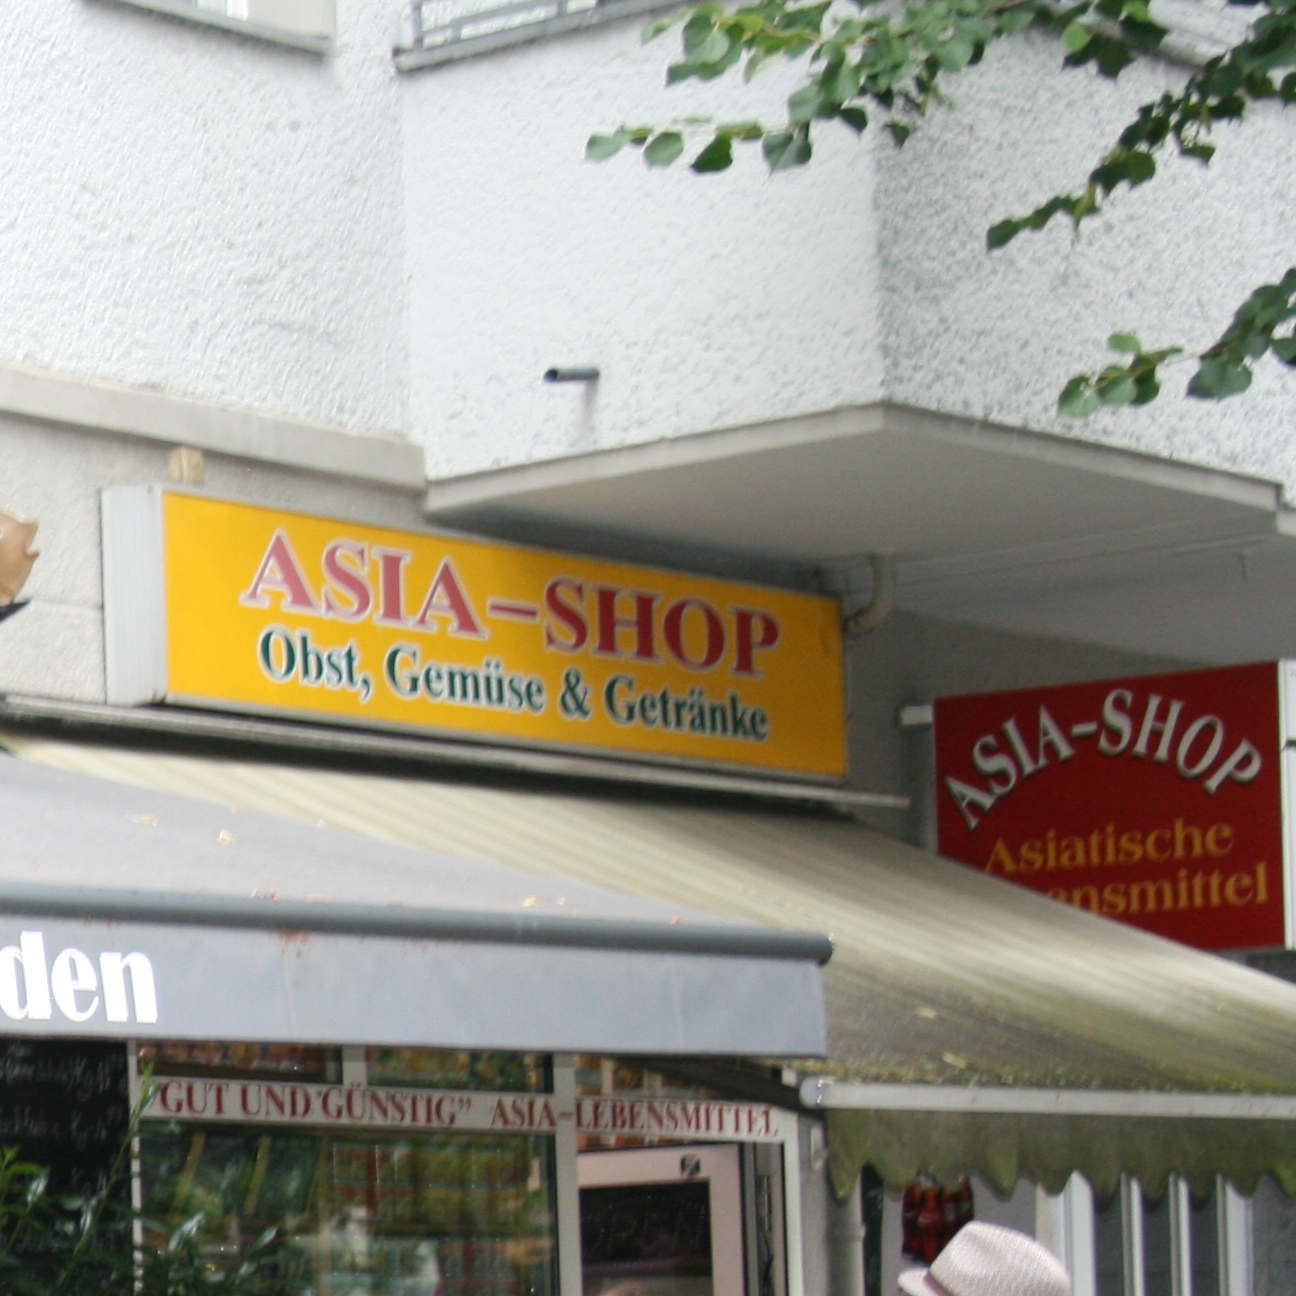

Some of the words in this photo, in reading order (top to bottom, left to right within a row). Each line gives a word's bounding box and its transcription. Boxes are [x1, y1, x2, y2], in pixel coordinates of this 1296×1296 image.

[240, 528, 781, 678] ASIA-SHOP
[258, 624, 373, 702] Obst,
[385, 642, 546, 714] Gemüse
[559, 665, 592, 719] &
[603, 671, 771, 744] Getränke
[944, 688, 1263, 833] ASIA-SHOP
[985, 817, 1235, 876] Asiatische
[1048, 861, 1270, 915] nsmittel
[160, 1080, 229, 1115] GUT
[240, 1085, 311, 1118] UND
